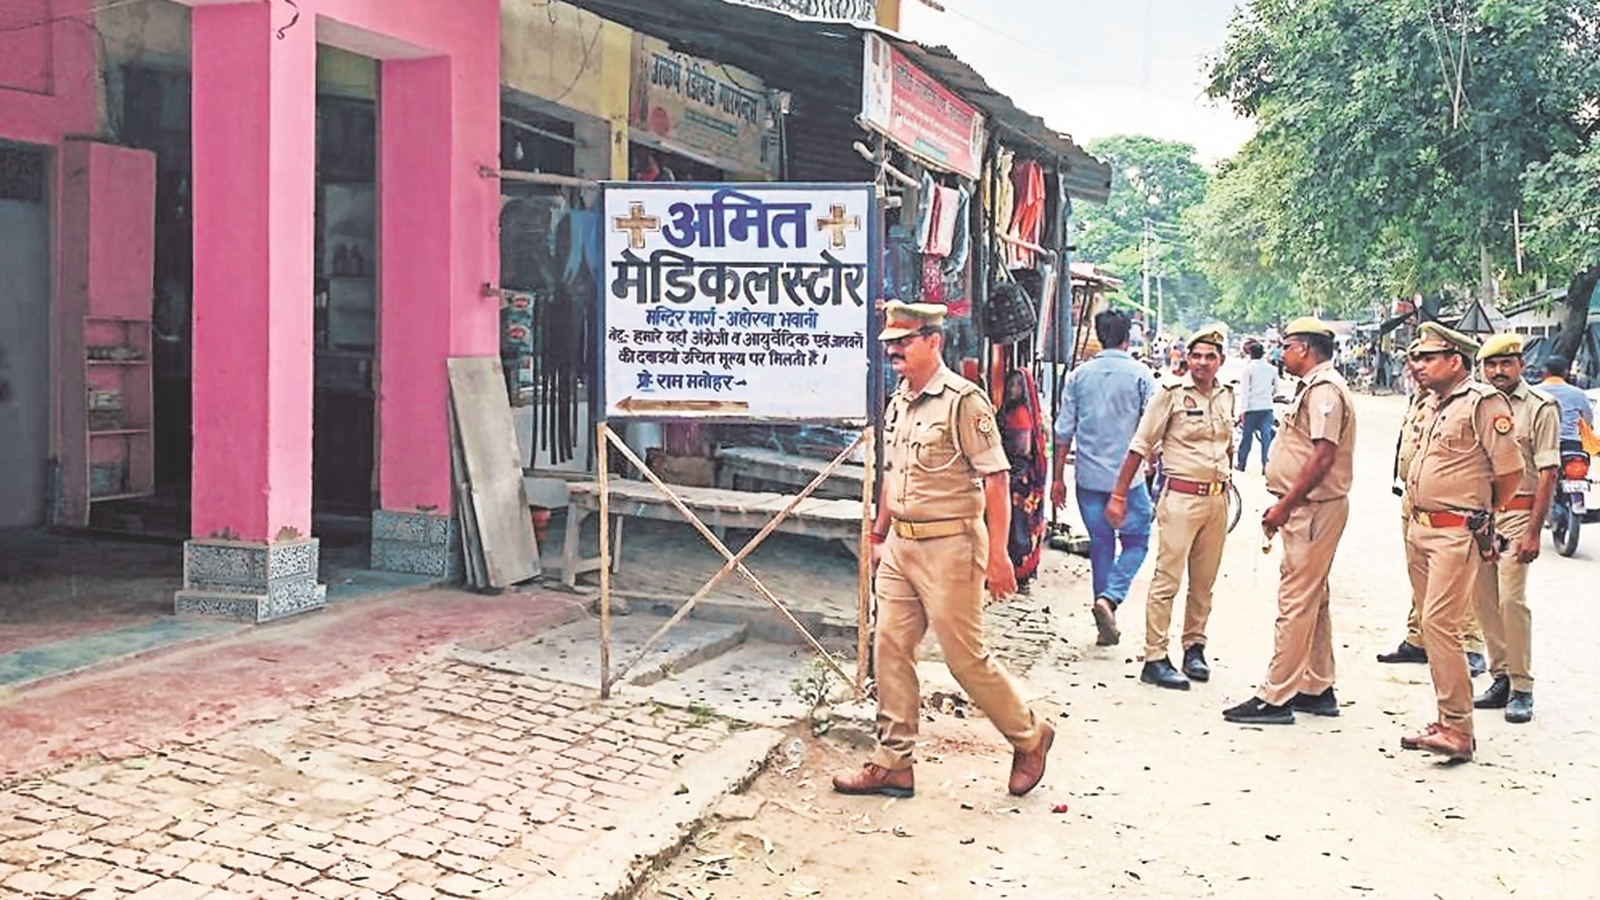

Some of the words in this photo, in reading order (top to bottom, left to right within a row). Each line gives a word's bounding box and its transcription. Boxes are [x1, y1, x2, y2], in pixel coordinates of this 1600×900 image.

[662, 189, 812, 248] अमित
[611, 248, 783, 304] मेडिकल
[782, 250, 866, 306] स्टोर
[645, 305, 686, 328] मन्दिर
[688, 306, 717, 327] मार्ग
[778, 307, 819, 328] भवानी
[632, 327, 663, 345] हमारे
[691, 327, 729, 347] अंग्रेजी
[731, 331, 742, 345] व
[812, 331, 831, 348] एवं
[618, 346, 636, 364] की
[681, 346, 716, 365] उचित
[717, 352, 746, 370] मूल्य
[749, 352, 767, 367] पर
[768, 349, 806, 367] मिलती
[656, 373, 684, 389] राम
